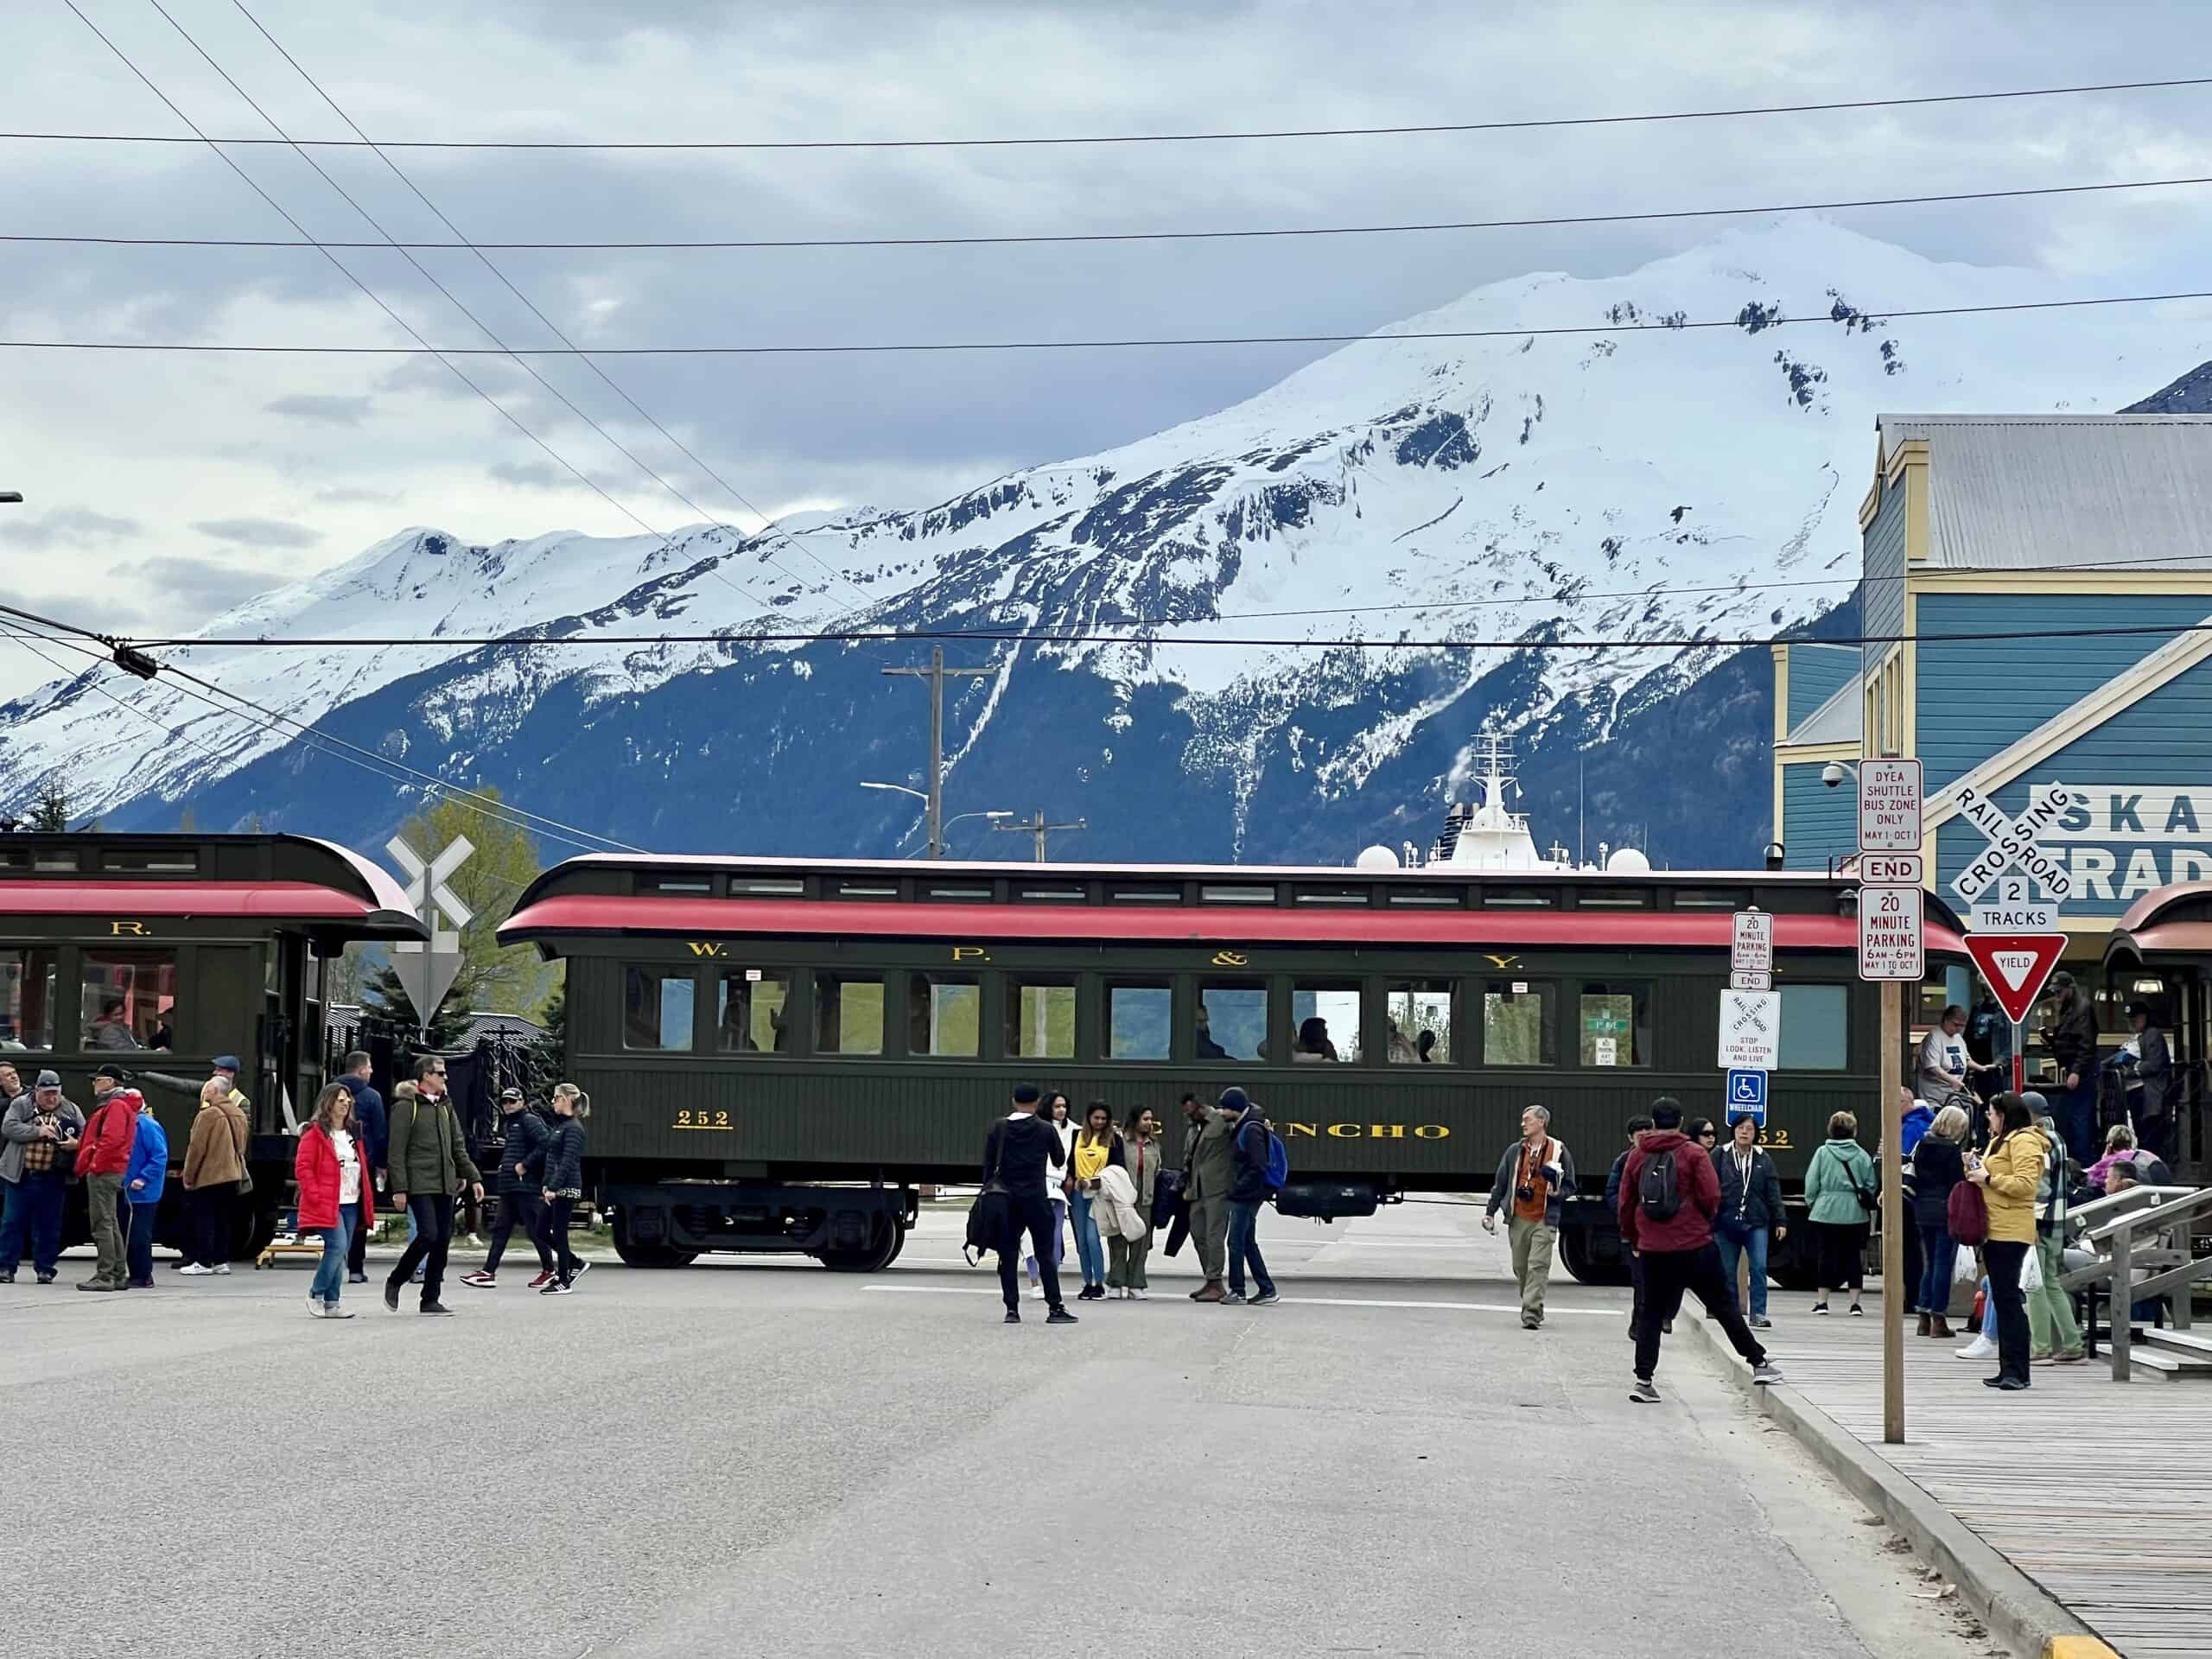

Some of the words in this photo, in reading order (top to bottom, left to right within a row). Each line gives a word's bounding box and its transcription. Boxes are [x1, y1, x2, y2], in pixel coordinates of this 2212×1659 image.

[1876, 772, 1904, 782] DYEA
[1867, 786, 1913, 796] SHUTTLE
[1865, 800, 1885, 810] BUS
[1890, 800, 1916, 810] ZONE
[1877, 814, 1904, 824] ONLY
[1866, 831, 1882, 840] MAY
[1894, 831, 1911, 840] OCT
[1956, 788, 2003, 838] RAIL
[2018, 847, 2069, 894] ROAD
[1959, 789, 2068, 896] CROSSING
[1871, 862, 1912, 876] END
[2007, 882, 2021, 900] 2
[1880, 897, 1900, 912] 20
[1746, 919, 1759, 930] 20
[1871, 916, 1910, 930] MINUTE
[1982, 912, 2047, 925] TRACKS
[110, 921, 152, 935] R.
[1740, 931, 1764, 940] MINUTE
[1866, 934, 1915, 948] PARKING
[1737, 942, 1767, 951] PARKING
[685, 943, 728, 956] W.
[951, 947, 991, 961] P.
[1211, 951, 1248, 965] &
[1482, 954, 1523, 969] Y.
[2000, 957, 2030, 968] YIELD
[1733, 999, 1767, 1030] CROSSING
[677, 1109, 728, 1126] 252
[1273, 1122, 1451, 1139] NCHO
[1758, 1129, 1789, 1145] 52
